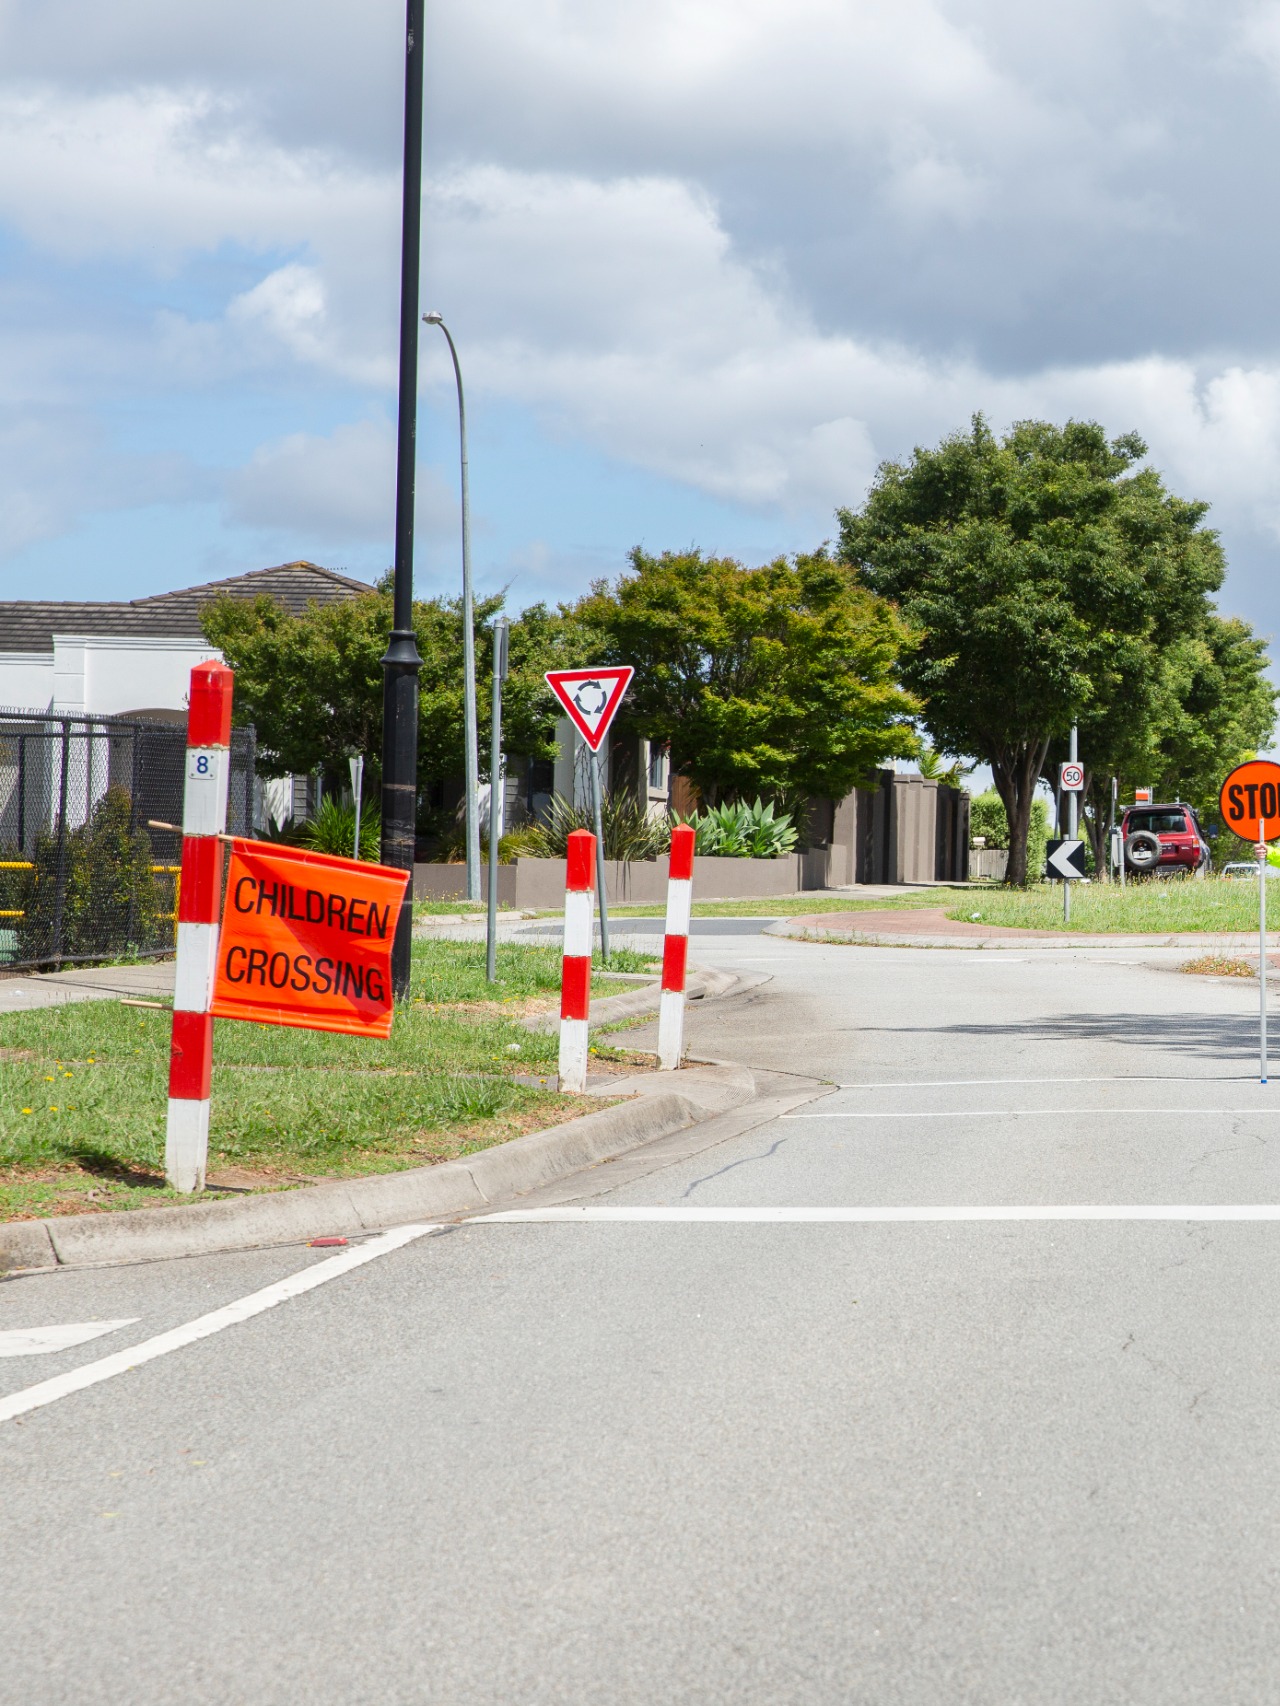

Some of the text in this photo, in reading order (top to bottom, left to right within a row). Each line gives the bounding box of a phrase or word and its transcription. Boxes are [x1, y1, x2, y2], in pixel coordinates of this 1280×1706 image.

[197, 755, 209, 774] 8
[1066, 771, 1080, 782] 50
[234, 876, 391, 939] CHILDREN
[225, 945, 385, 1002] CROSSING
